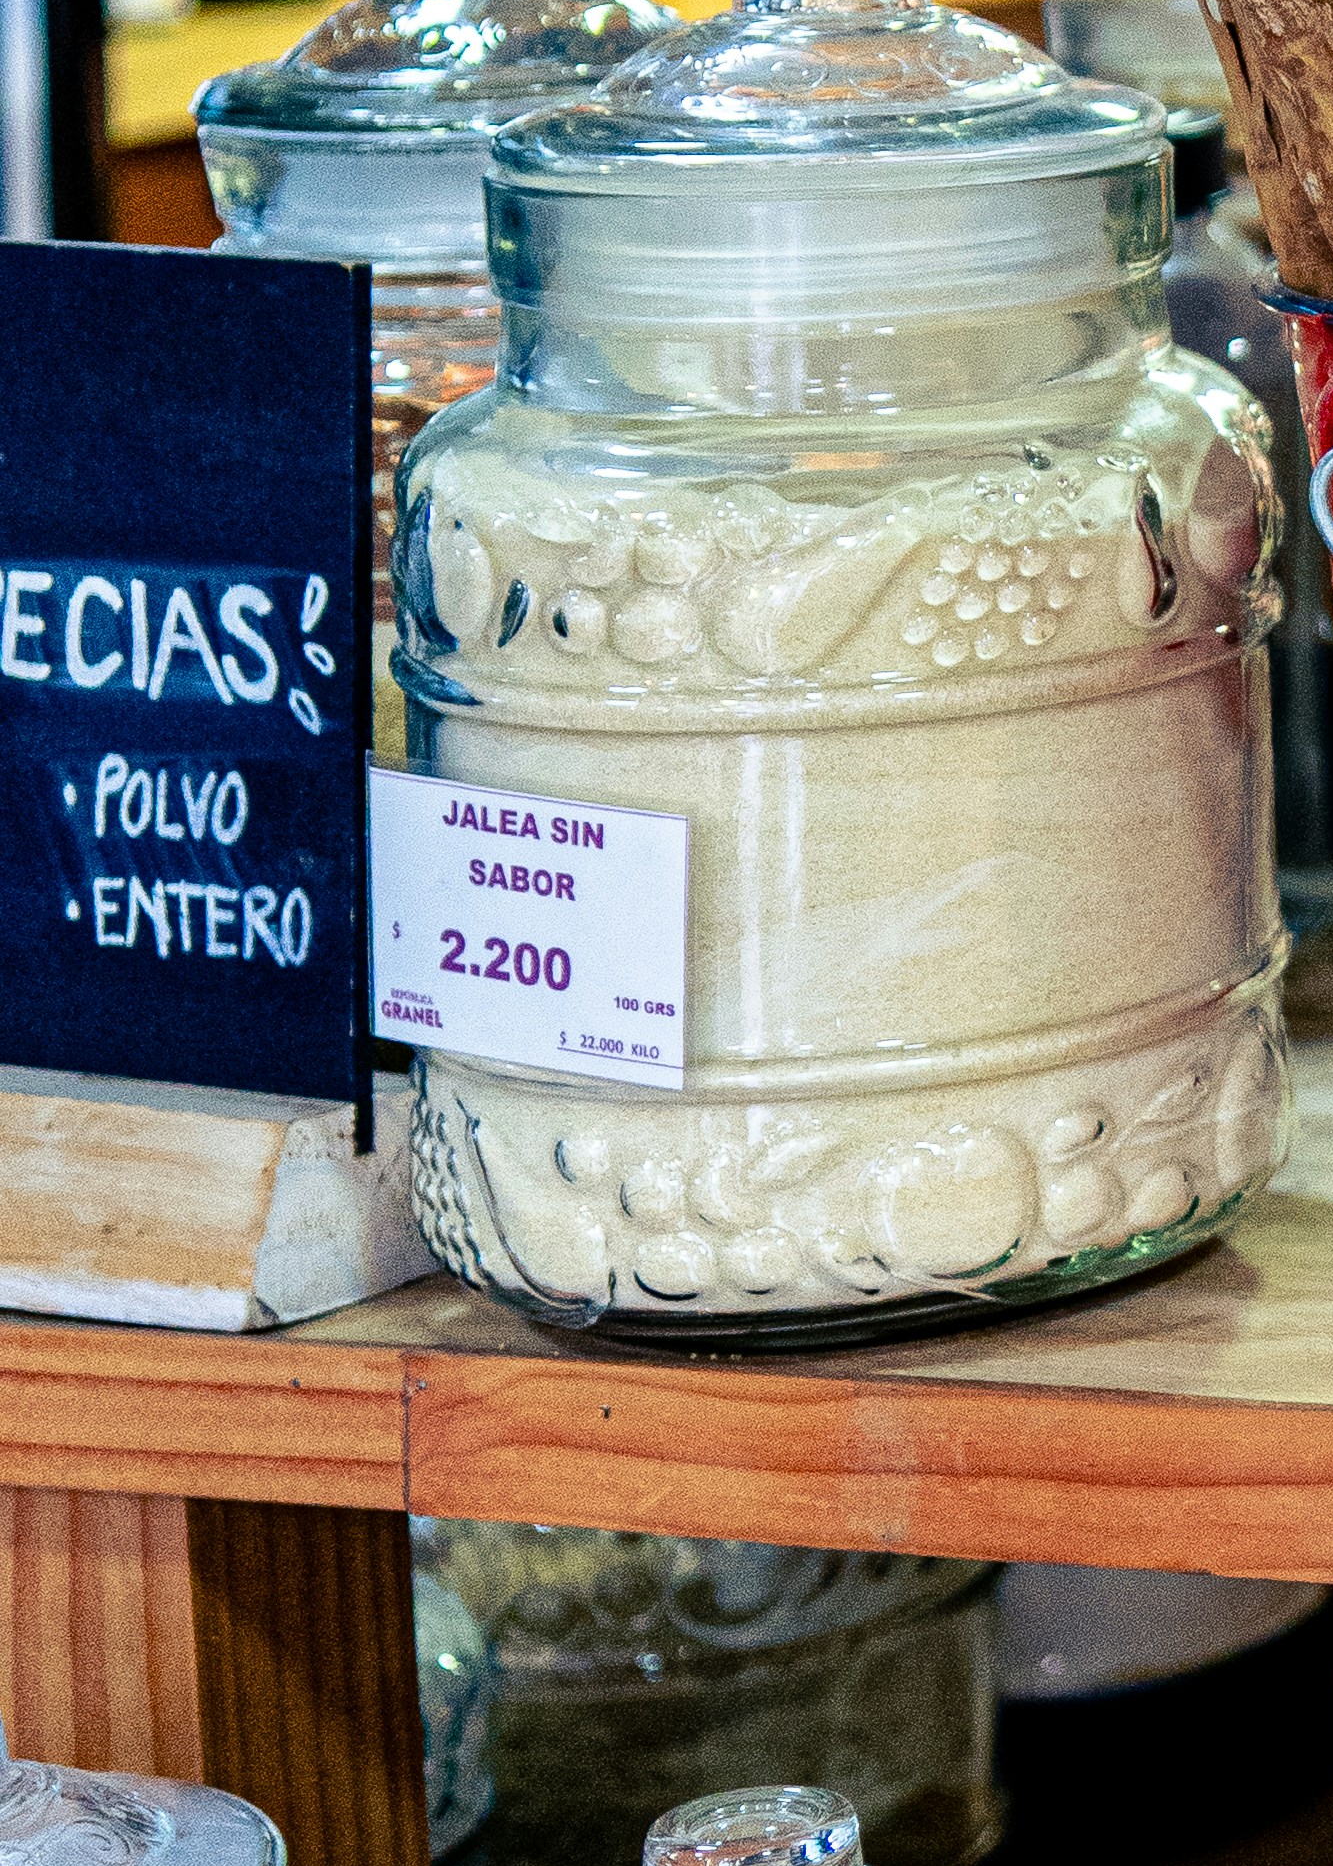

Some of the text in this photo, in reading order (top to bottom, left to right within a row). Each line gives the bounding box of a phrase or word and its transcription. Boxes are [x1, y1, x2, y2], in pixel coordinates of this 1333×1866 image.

[0, 569, 280, 705] ECIAS
[95, 753, 249, 845] POLVO
[442, 799, 605, 850] JALEA SIN
[468, 858, 577, 901] SABOR
[93, 875, 312, 967] ENTERO
[392, 921, 572, 992] $ 2.200
[381, 999, 444, 1029] GRANEL
[613, 995, 676, 1017] 100 GRS
[559, 1031, 660, 1060] $ 22.000 KILO
